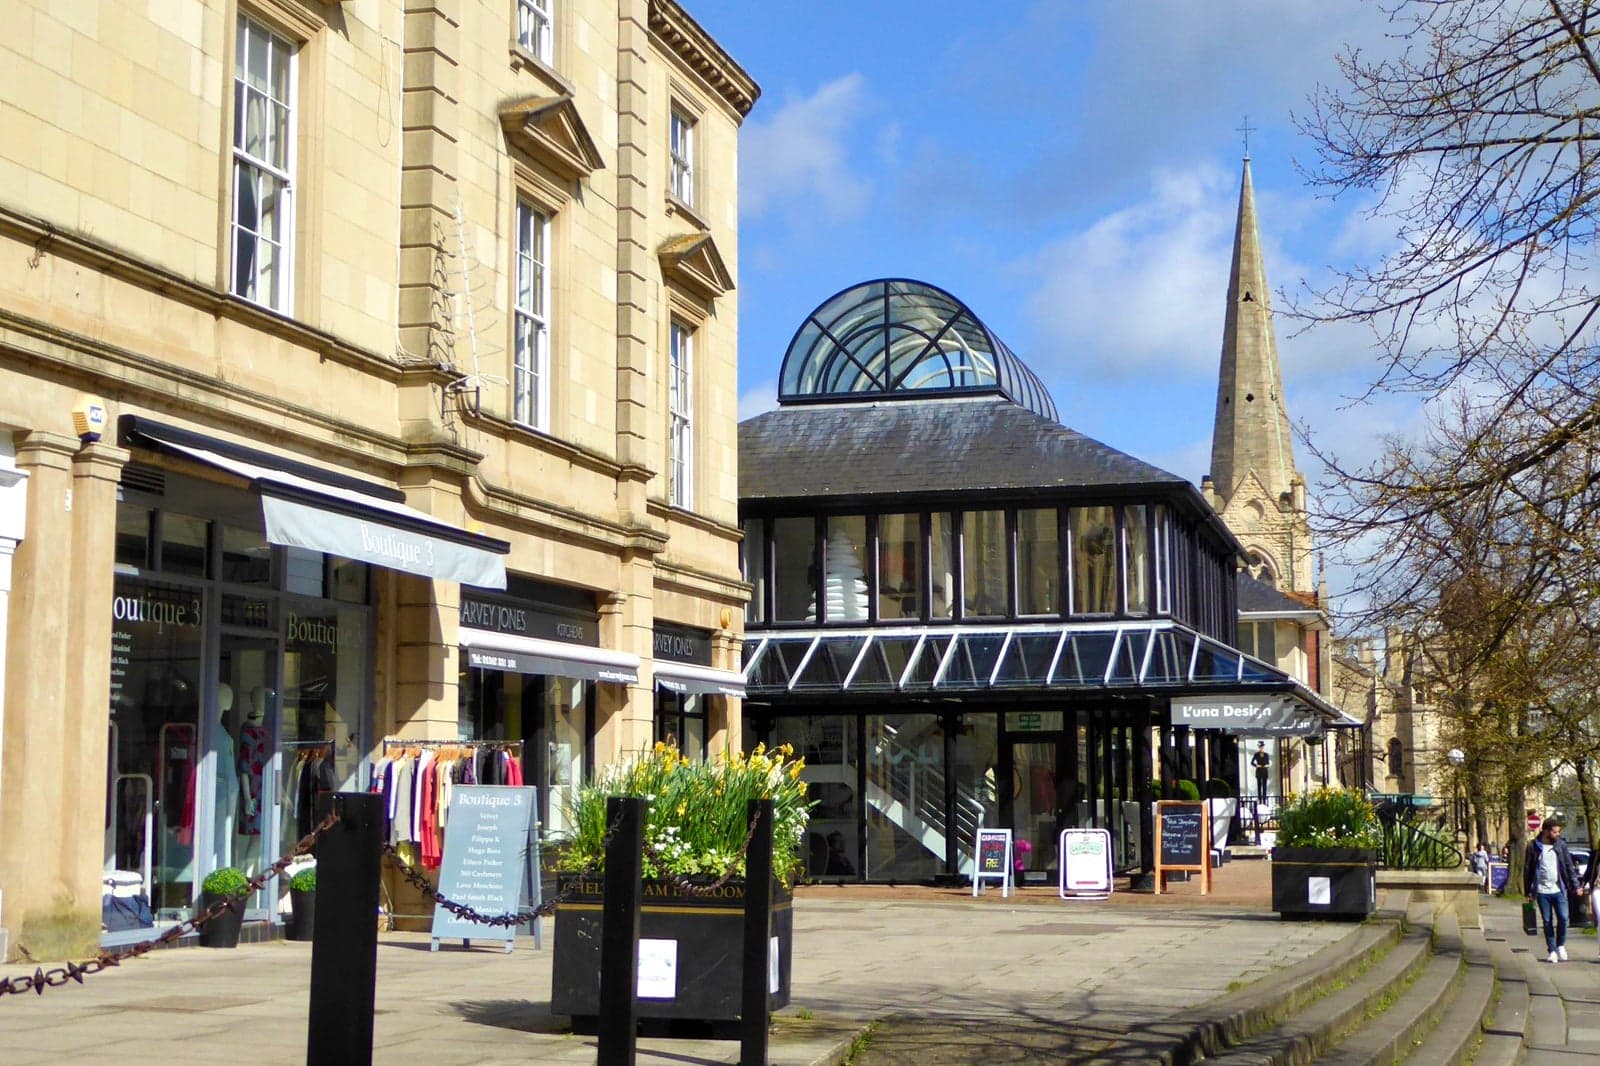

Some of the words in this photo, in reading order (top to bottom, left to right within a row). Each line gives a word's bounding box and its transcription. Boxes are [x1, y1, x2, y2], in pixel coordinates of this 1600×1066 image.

[360, 523, 421, 568] Boutique
[425, 540, 434, 567] 3
[114, 592, 186, 634] outique
[191, 600, 200, 628] 3
[461, 601, 495, 626] ARVEY
[497, 606, 526, 631] JONES
[287, 610, 349, 654] Boutiqu
[556, 624, 584, 640] KITCHENS
[654, 633, 671, 654] RVEY
[673, 635, 693, 656] JONES
[1182, 705, 1219, 718] L'una
[1223, 704, 1271, 719] Design
[459, 793, 511, 808] Boutique
[513, 794, 522, 806] 3
